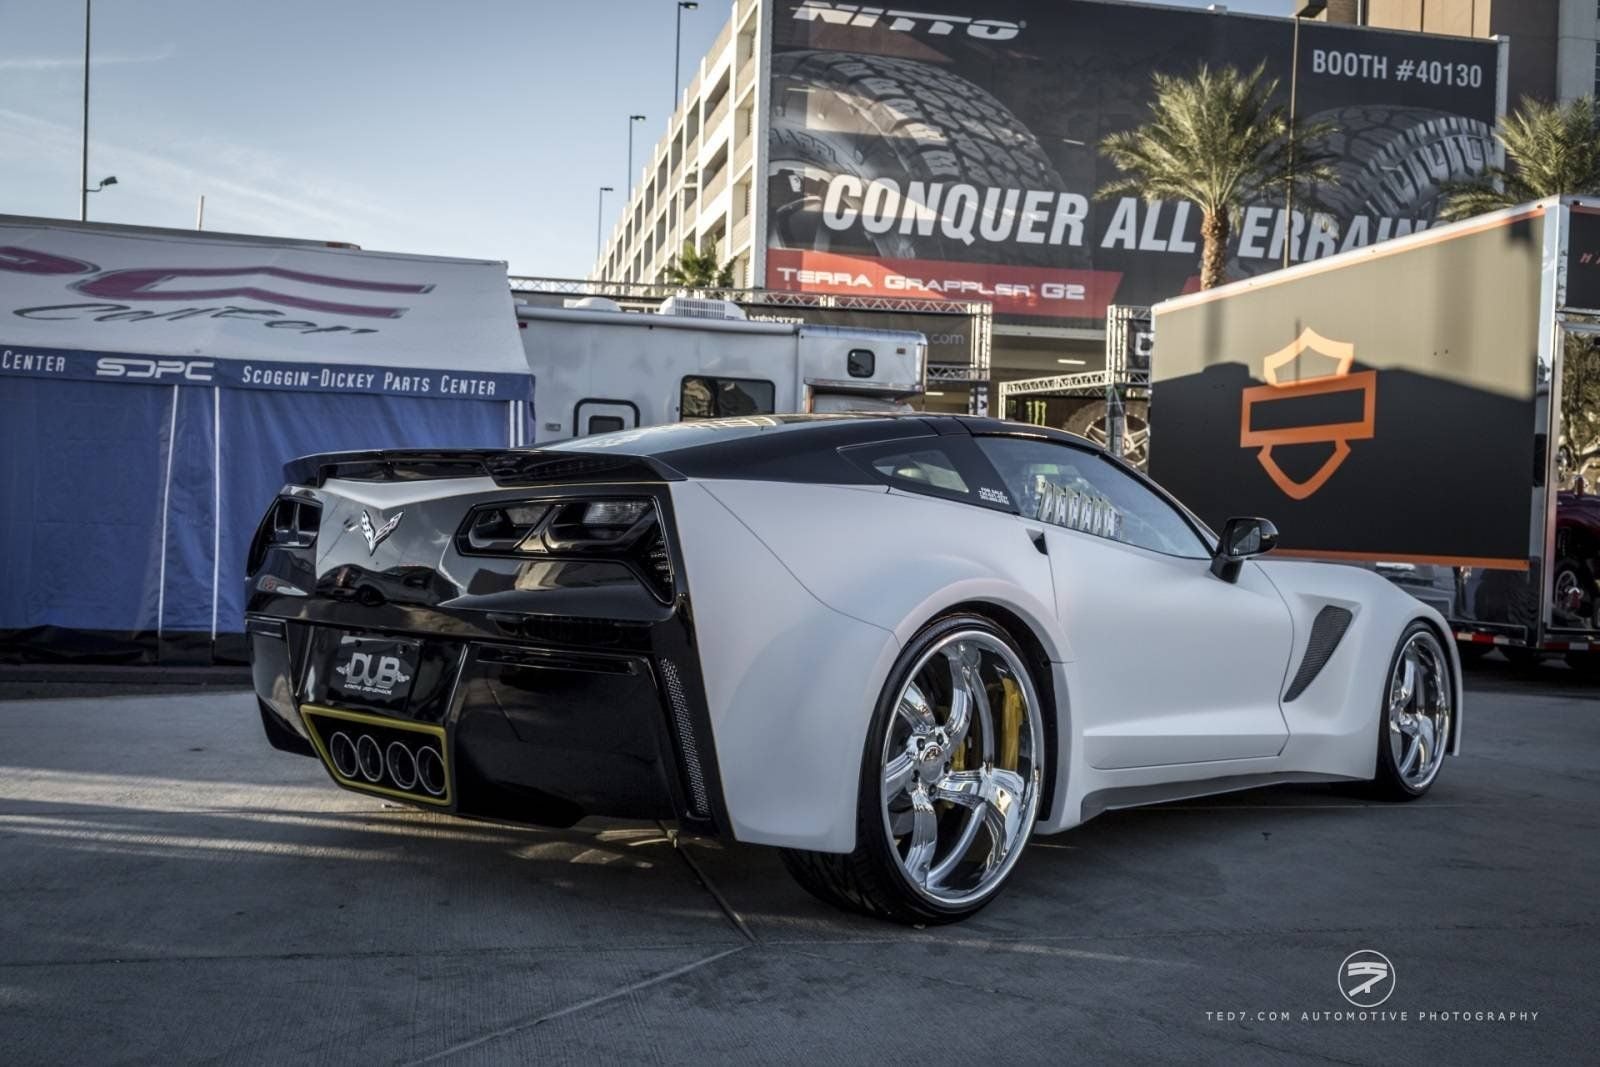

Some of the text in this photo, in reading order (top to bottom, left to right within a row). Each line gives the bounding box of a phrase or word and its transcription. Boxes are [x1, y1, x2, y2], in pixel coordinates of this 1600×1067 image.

[790, 0, 1019, 40] NITTO
[1312, 49, 1483, 88] BOOTH #40130
[822, 174, 1089, 246] CONQUER
[1101, 197, 1196, 254] ALL
[777, 267, 1086, 300] TERRA GRAPPLER G2
[2, 350, 215, 381] CENTER SDPC
[242, 365, 497, 396] SCOGGIN-DICKEY PARTS CENTER
[345, 652, 400, 688] DUB
